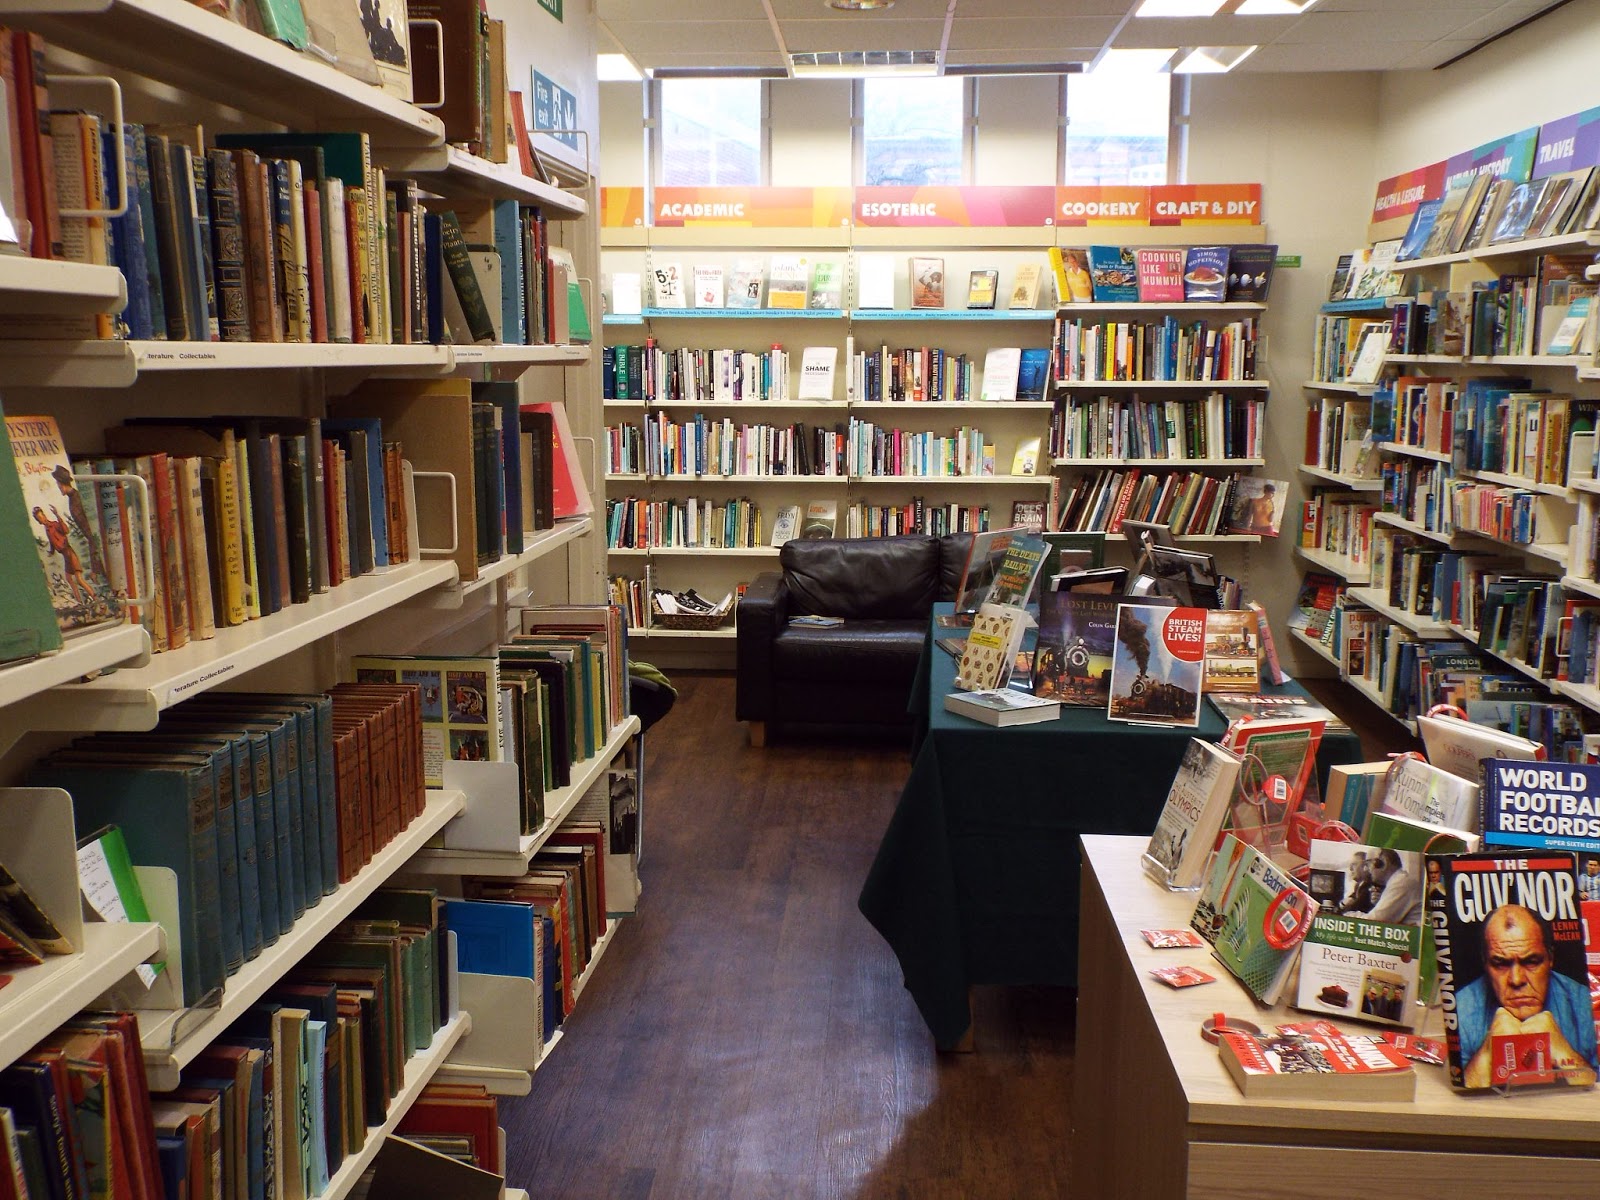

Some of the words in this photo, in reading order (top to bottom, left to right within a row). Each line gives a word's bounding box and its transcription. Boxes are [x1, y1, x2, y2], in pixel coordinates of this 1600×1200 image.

[536, 81, 548, 104] Fire
[539, 108, 549, 127] exit
[1540, 137, 1575, 164] TRAVEL
[1479, 157, 1513, 179] HISTORY
[1376, 192, 1397, 211] HEALTH
[1401, 185, 1425, 205] LEISURE
[660, 203, 744, 217] ACADEMIC
[862, 203, 936, 217] ESOTERIC
[1062, 202, 1140, 215] COOKERY
[1156, 202, 1208, 215] CRAFT
[1212, 202, 1223, 215] &
[1227, 201, 1256, 215] DIY
[1142, 252, 1180, 262] COOKING
[655, 266, 678, 284] 5:2
[1142, 264, 1160, 274] LIKE
[6, 421, 52, 438] YSTERY
[10, 440, 39, 457] EVER
[38, 439, 60, 455] WAS
[1014, 513, 1043, 522] BRAIN
[1007, 547, 1018, 557] THE
[1019, 549, 1041, 562] DEATH
[1004, 560, 1033, 573] RAILWAY
[1061, 600, 1087, 609] LOST
[1168, 619, 1202, 627] BRITISH
[1168, 626, 1202, 634] STEAM
[1167, 633, 1201, 642] LIVES!
[200, 664, 235, 682] Collectables
[1219, 696, 1308, 704] TRAINS
[1499, 767, 1587, 792] WORLD
[1169, 789, 1201, 822] OLYMPICS
[1500, 813, 1600, 838] RECORDS
[1566, 840, 1585, 848] SIXTH
[1493, 859, 1528, 870] THE
[1430, 900, 1445, 908] THE
[1454, 871, 1578, 923] GUV'NOR
[1314, 917, 1354, 934] INSIDE
[1358, 923, 1381, 938] THE
[1385, 927, 1410, 943] BOX
[1552, 922, 1578, 931] LENNY
[1315, 931, 1325, 940] My
[1354, 936, 1367, 944] Test
[1367, 938, 1386, 948] Match
[1387, 941, 1410, 952] Special
[1553, 931, 1580, 941] McLEAN
[1322, 947, 1353, 963] Peter
[1358, 953, 1397, 971] Baxter
[1432, 911, 1458, 1031] GUV'NOR
